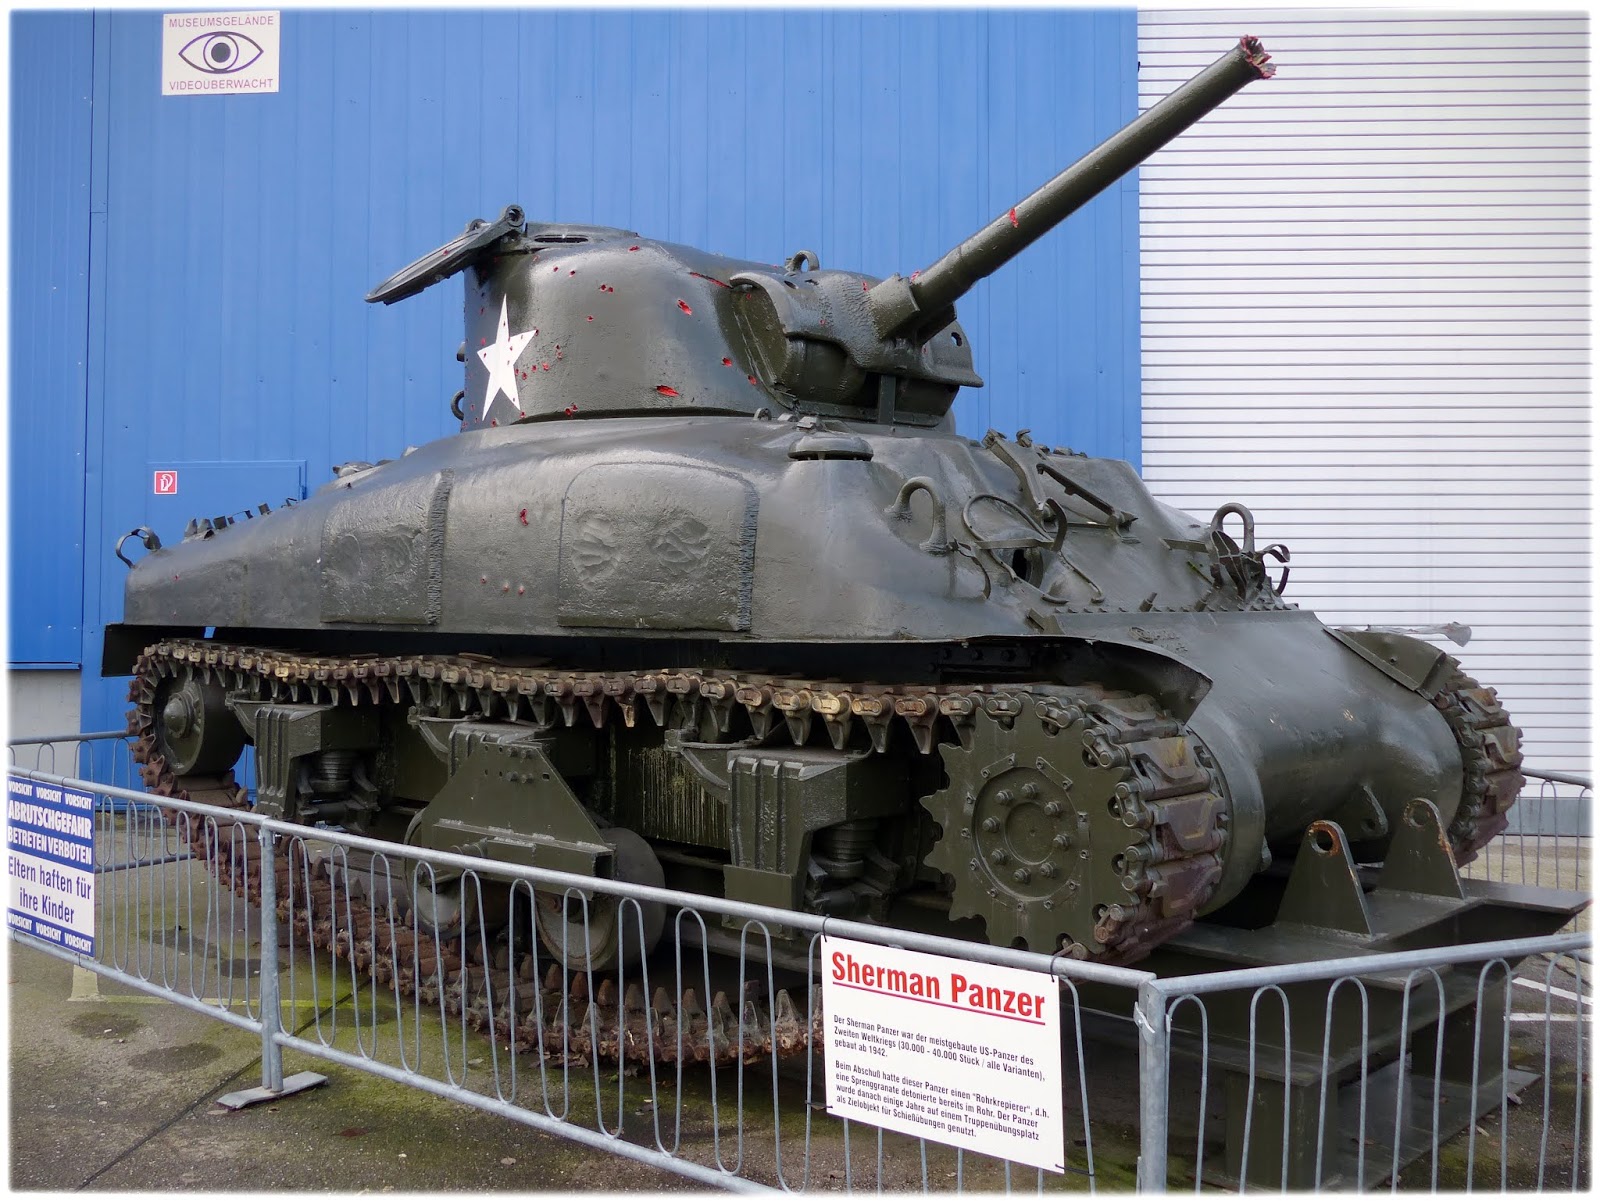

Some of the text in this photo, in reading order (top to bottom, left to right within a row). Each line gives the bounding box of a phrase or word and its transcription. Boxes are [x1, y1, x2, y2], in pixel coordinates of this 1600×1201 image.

[169, 14, 274, 28] MUSEUMSGELÄNDE
[8, 780, 92, 810] VORSICHT VORSICHT VORSICHT
[8, 800, 92, 839] ABRUTSCHGEFAHR
[7, 825, 92, 865] BETRETEN VERBOTEN
[8, 855, 91, 899] Eltern haften für
[20, 887, 74, 924] ihre Kinder
[8, 912, 92, 952] VORSICHT VORSICHT VORSICHT
[832, 951, 1045, 1018] Sherman Panzer
[834, 1014, 1034, 1065] Der Sherman Panzer war der meistgebaute US-Panzer des
[834, 1026, 859, 1039] Zweiten
[861, 1032, 896, 1048] Weltkriegs
[898, 1040, 925, 1054] (30.000
[932, 1049, 957, 1061] 40.000
[987, 1060, 1000, 1070] alle
[834, 1039, 888, 1057] gebaut ab 1942.
[835, 1060, 851, 1071] Beim
[853, 1064, 881, 1078] Abschuß
[882, 1071, 900, 1083] hatte
[901, 1076, 923, 1088] dieser
[925, 1081, 948, 1094] Panzer
[950, 1088, 971, 1100] einen
[1035, 1107, 1050, 1119] d.h.
[835, 1072, 1038, 1128] eine Sprenggranate detonierte bereits im Rohr. Der Panzer
[836, 1084, 1039, 1140] wurde danach einige Jahre auf einem Truppenübungsplatz
[836, 1094, 846, 1104] als
[848, 1096, 880, 1112] Zielobjekt
[881, 1105, 891, 1115] für
[947, 1123, 976, 1137] genutzt.
